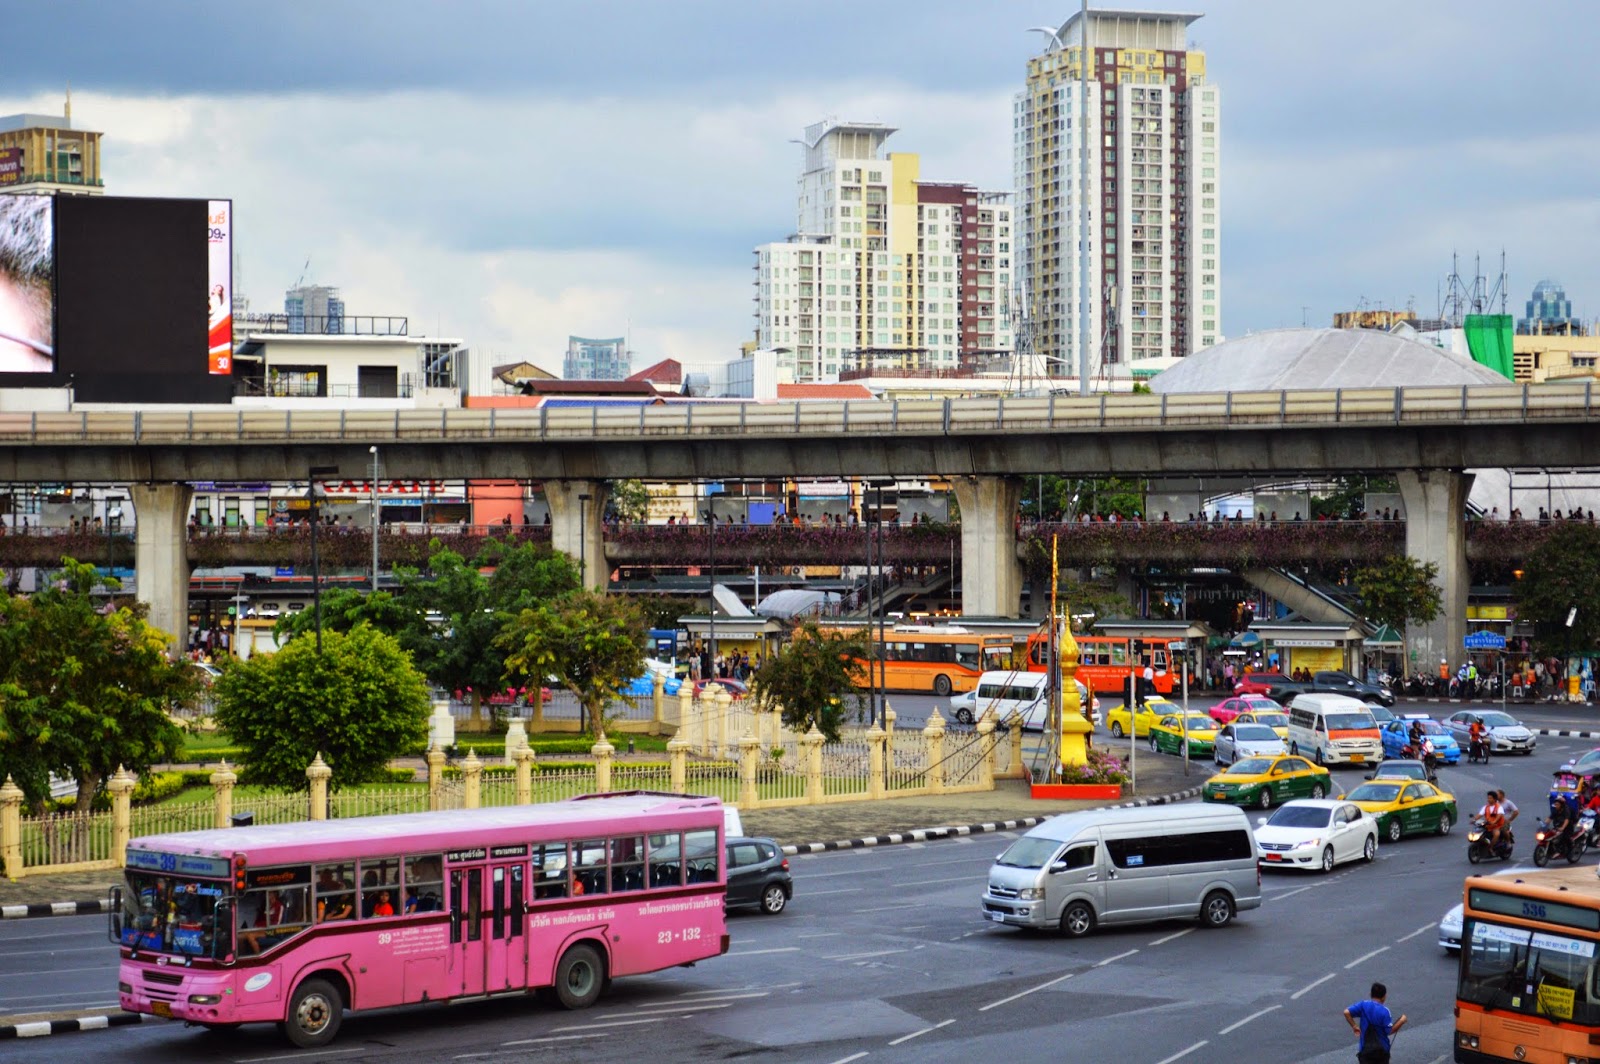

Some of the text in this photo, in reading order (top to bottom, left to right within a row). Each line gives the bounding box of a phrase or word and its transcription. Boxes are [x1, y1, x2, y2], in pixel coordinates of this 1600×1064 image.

[160, 854, 177, 872] 39
[1522, 901, 1546, 918] 536
[378, 932, 392, 945] 39
